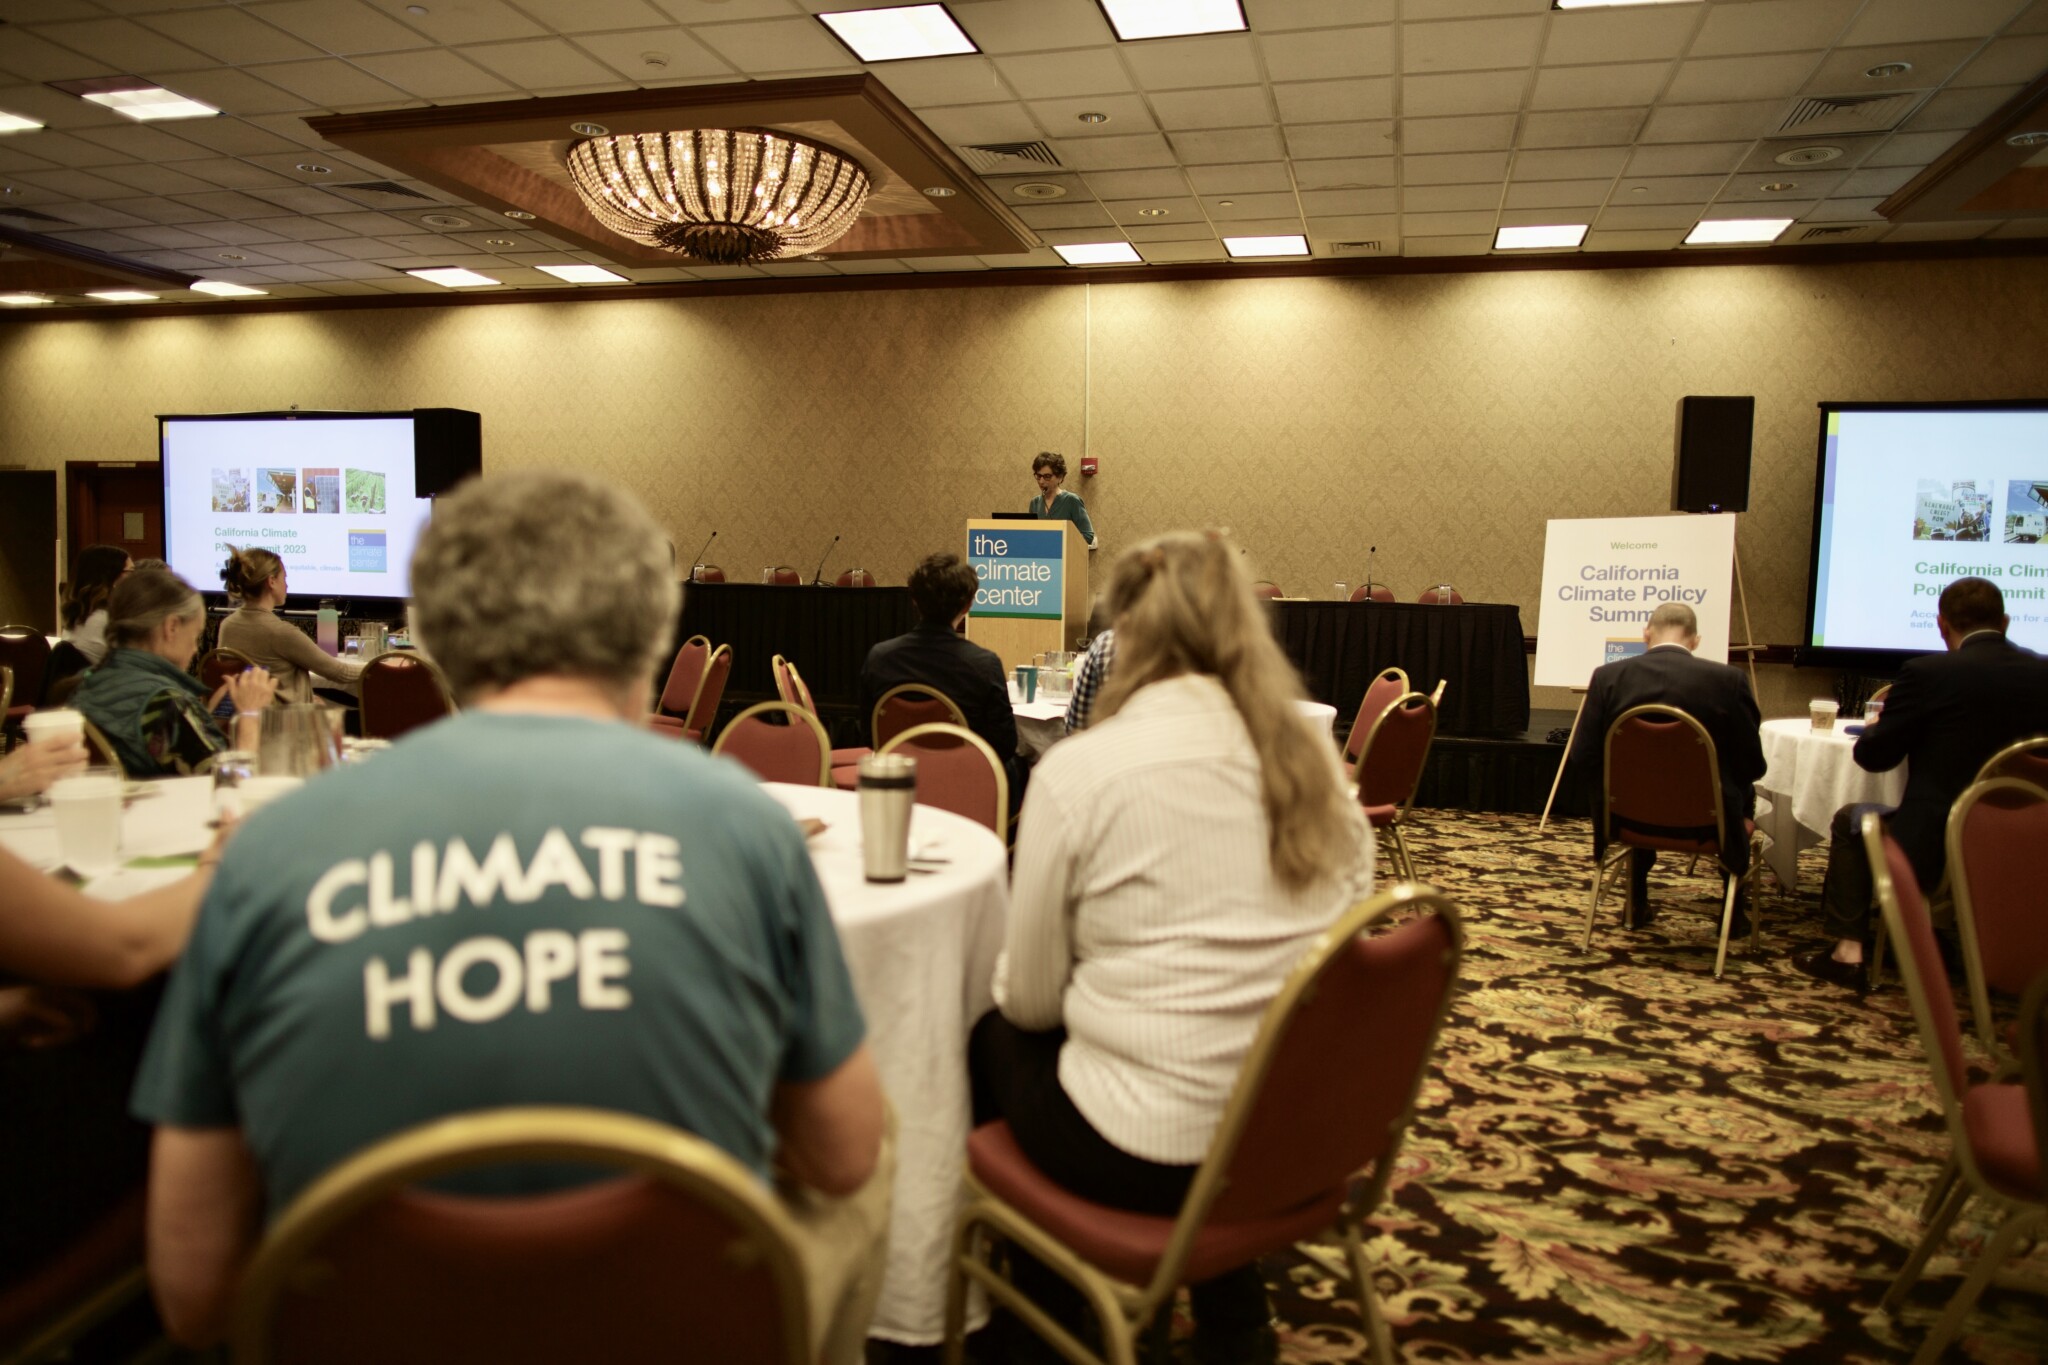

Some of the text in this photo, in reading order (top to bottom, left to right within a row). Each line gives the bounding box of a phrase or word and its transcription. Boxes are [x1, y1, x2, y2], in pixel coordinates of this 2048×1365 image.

[214, 527, 298, 538] California Climate
[350, 535, 365, 545] the
[283, 545, 307, 554] 2023
[974, 534, 1008, 556] the
[1610, 541, 1658, 550] Welcome
[974, 559, 1051, 582] climate
[1580, 565, 1679, 581] California
[1914, 561, 2048, 577] California Clim
[974, 586, 1042, 606] center
[1558, 585, 1708, 605] Climate Policy
[2001, 587, 2045, 599] mmit
[1589, 606, 1654, 622] Summ
[1910, 620, 1934, 629] safe
[1608, 643, 1624, 653] the
[307, 826, 686, 943] CLIMATE
[364, 928, 632, 1040] HOPE
